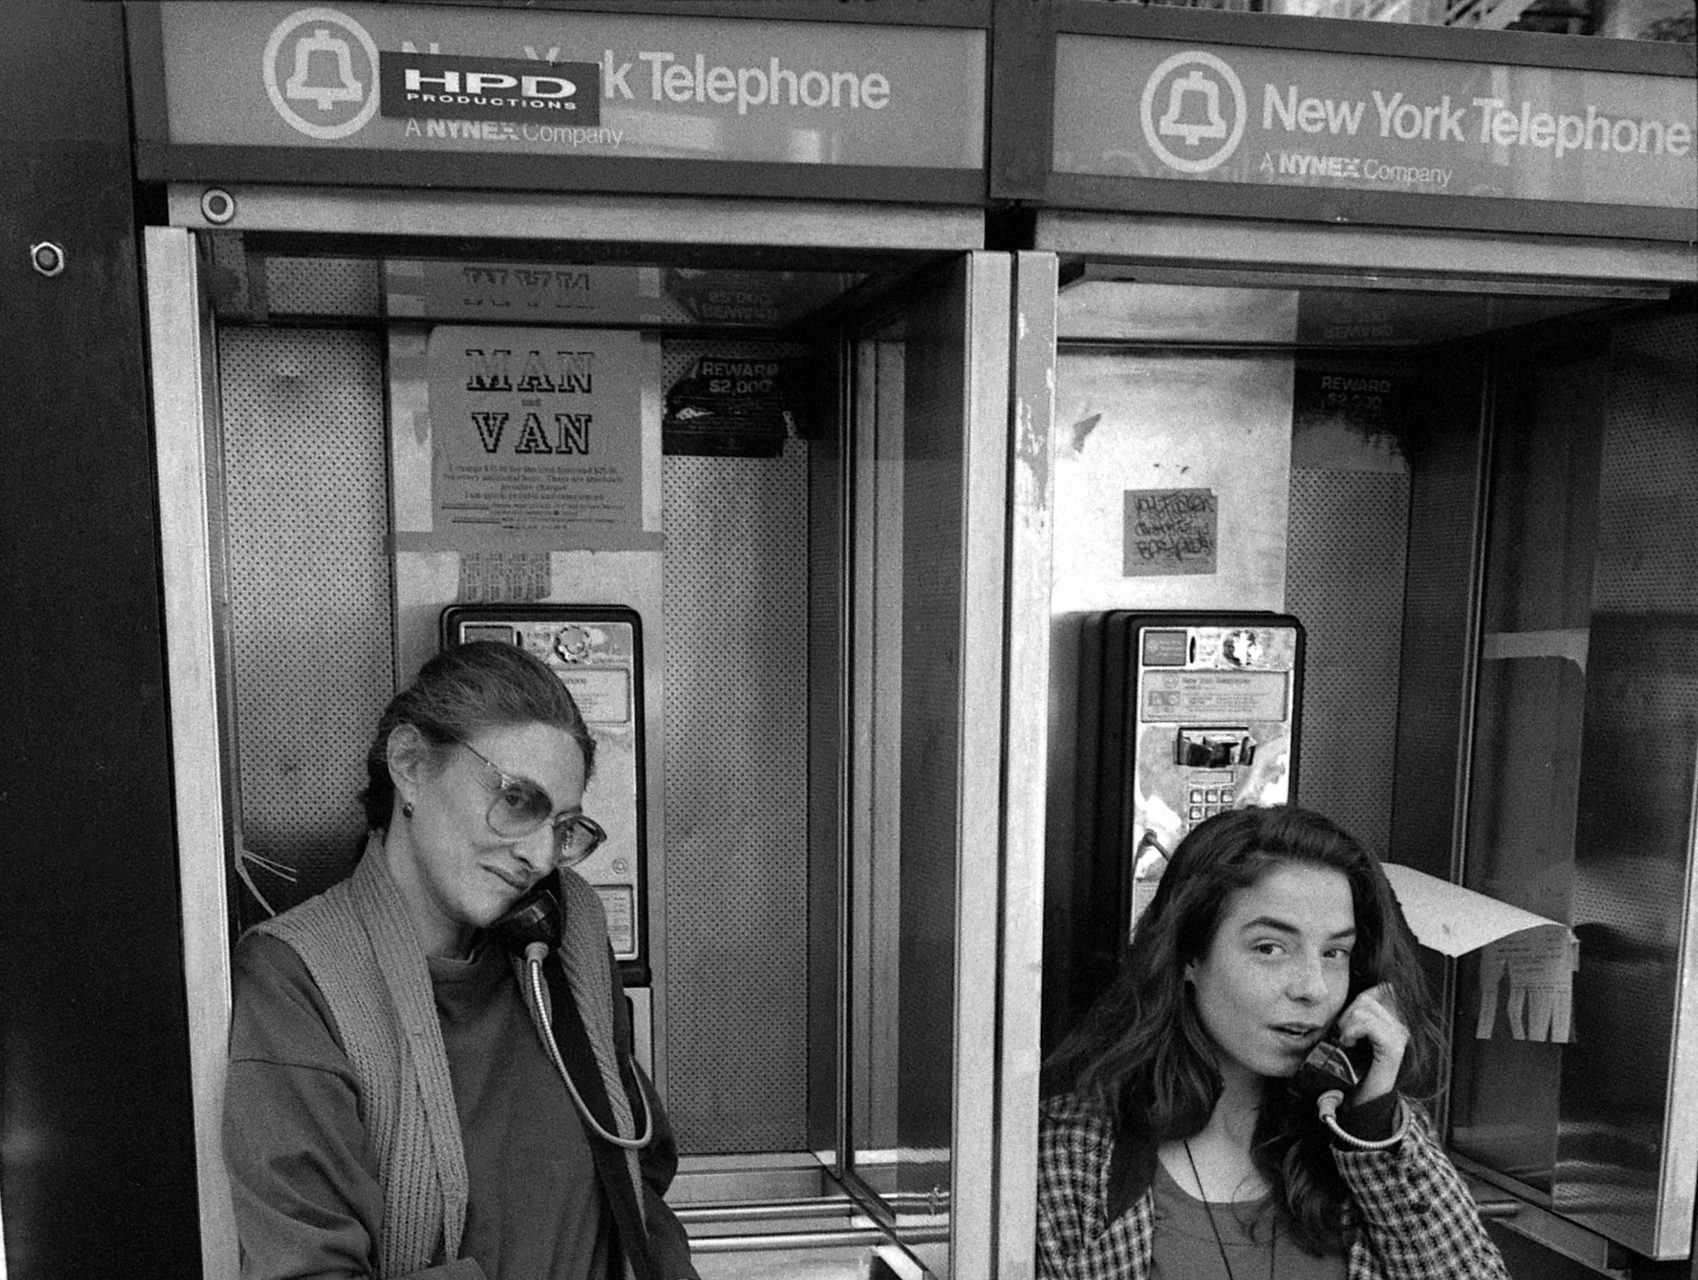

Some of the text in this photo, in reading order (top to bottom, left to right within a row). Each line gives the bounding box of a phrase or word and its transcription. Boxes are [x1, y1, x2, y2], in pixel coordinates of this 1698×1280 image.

[404, 68, 577, 99] HPD
[639, 51, 891, 114] Telephone
[406, 93, 577, 110] PRODUCTIONS
[404, 117, 623, 148] A NYNEX Company
[1262, 83, 1692, 158] New York Telephone
[1259, 153, 1453, 187] A NYNEX Company
[465, 349, 596, 393] MAN
[702, 361, 779, 377] REWARD
[471, 412, 593, 455] VAN
